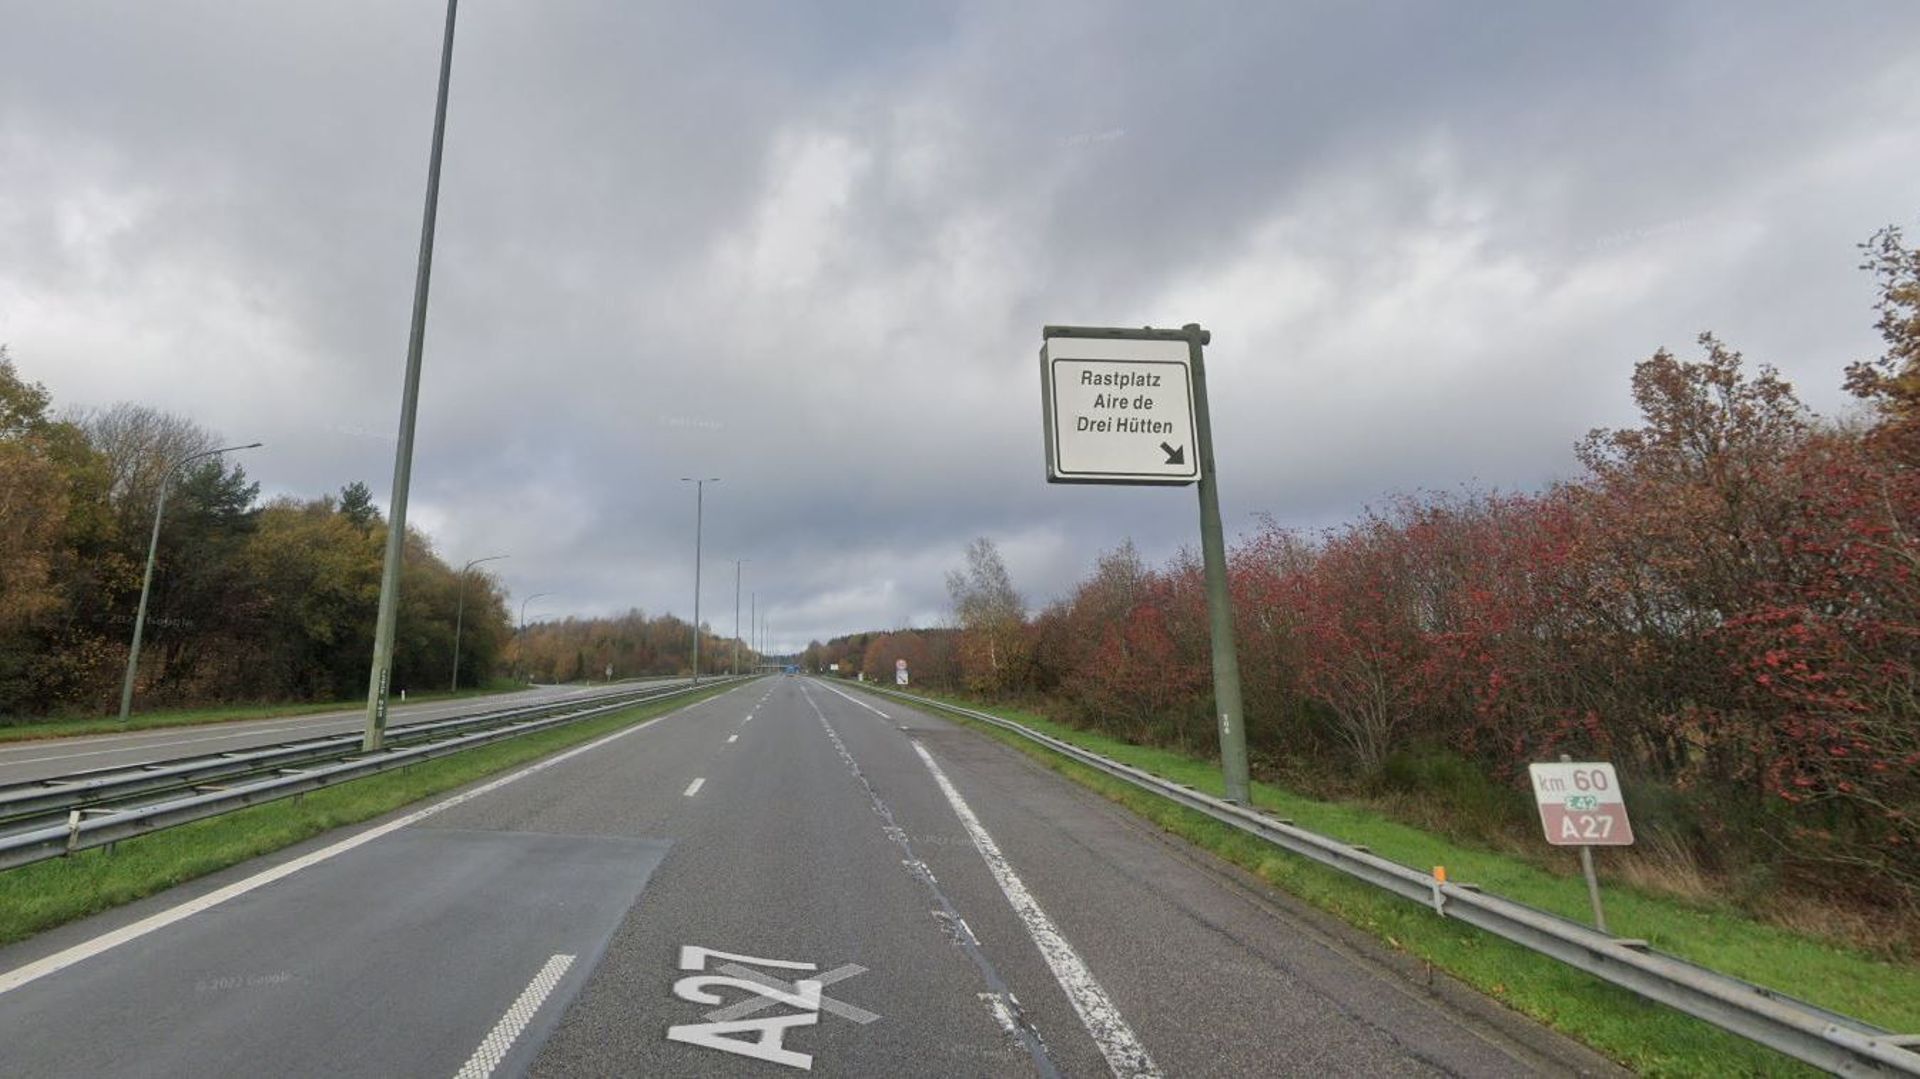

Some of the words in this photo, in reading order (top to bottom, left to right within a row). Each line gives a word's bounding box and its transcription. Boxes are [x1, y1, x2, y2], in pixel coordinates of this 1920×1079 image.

[1081, 370, 1161, 389] Rastplatz
[1094, 394, 1129, 408] Aire
[1133, 394, 1154, 409] de
[1077, 416, 1112, 432] Drei
[1116, 417, 1173, 434] Hütten
[1538, 774, 1566, 792] km
[1574, 770, 1608, 790] 60
[1562, 815, 1613, 838] A27
[667, 945, 822, 1070] A27
